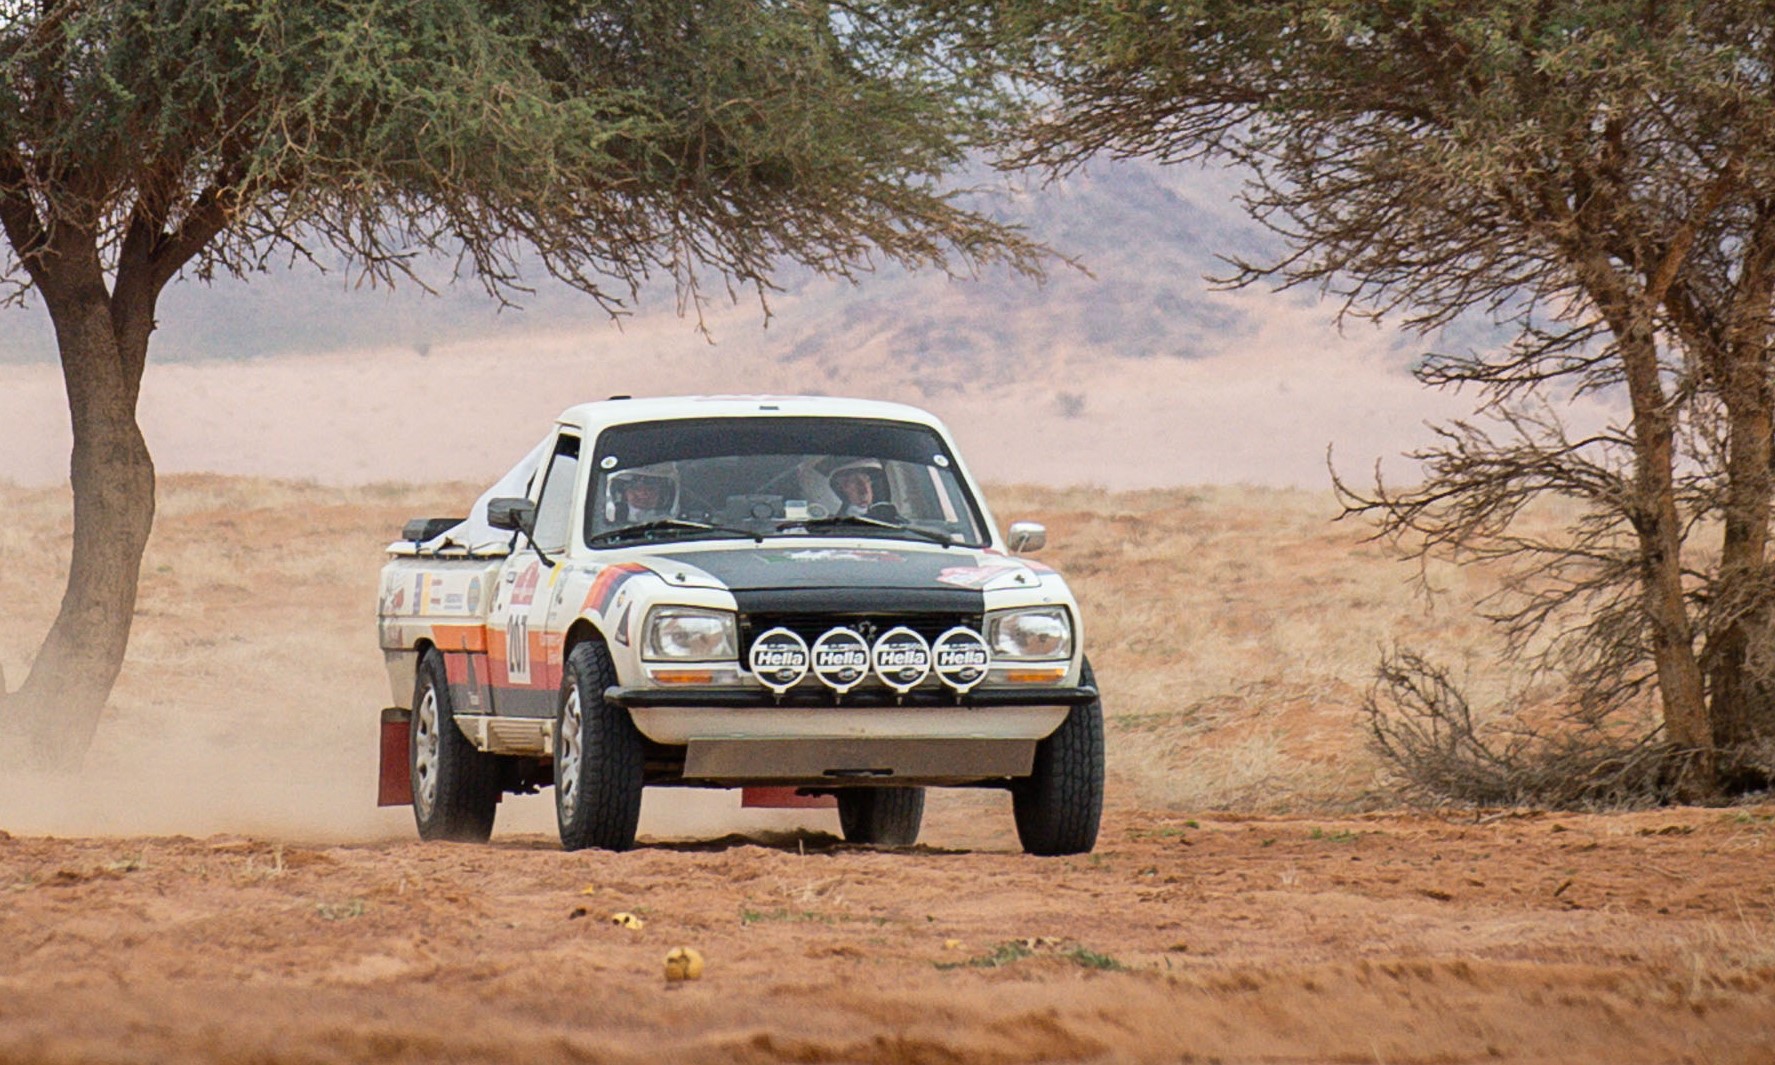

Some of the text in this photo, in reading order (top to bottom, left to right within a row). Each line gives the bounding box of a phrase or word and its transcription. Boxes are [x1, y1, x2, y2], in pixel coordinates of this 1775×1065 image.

[757, 651, 804, 665] Hella
[819, 651, 865, 665] Hella
[880, 650, 926, 665] Hella
[941, 650, 985, 665] Hella
